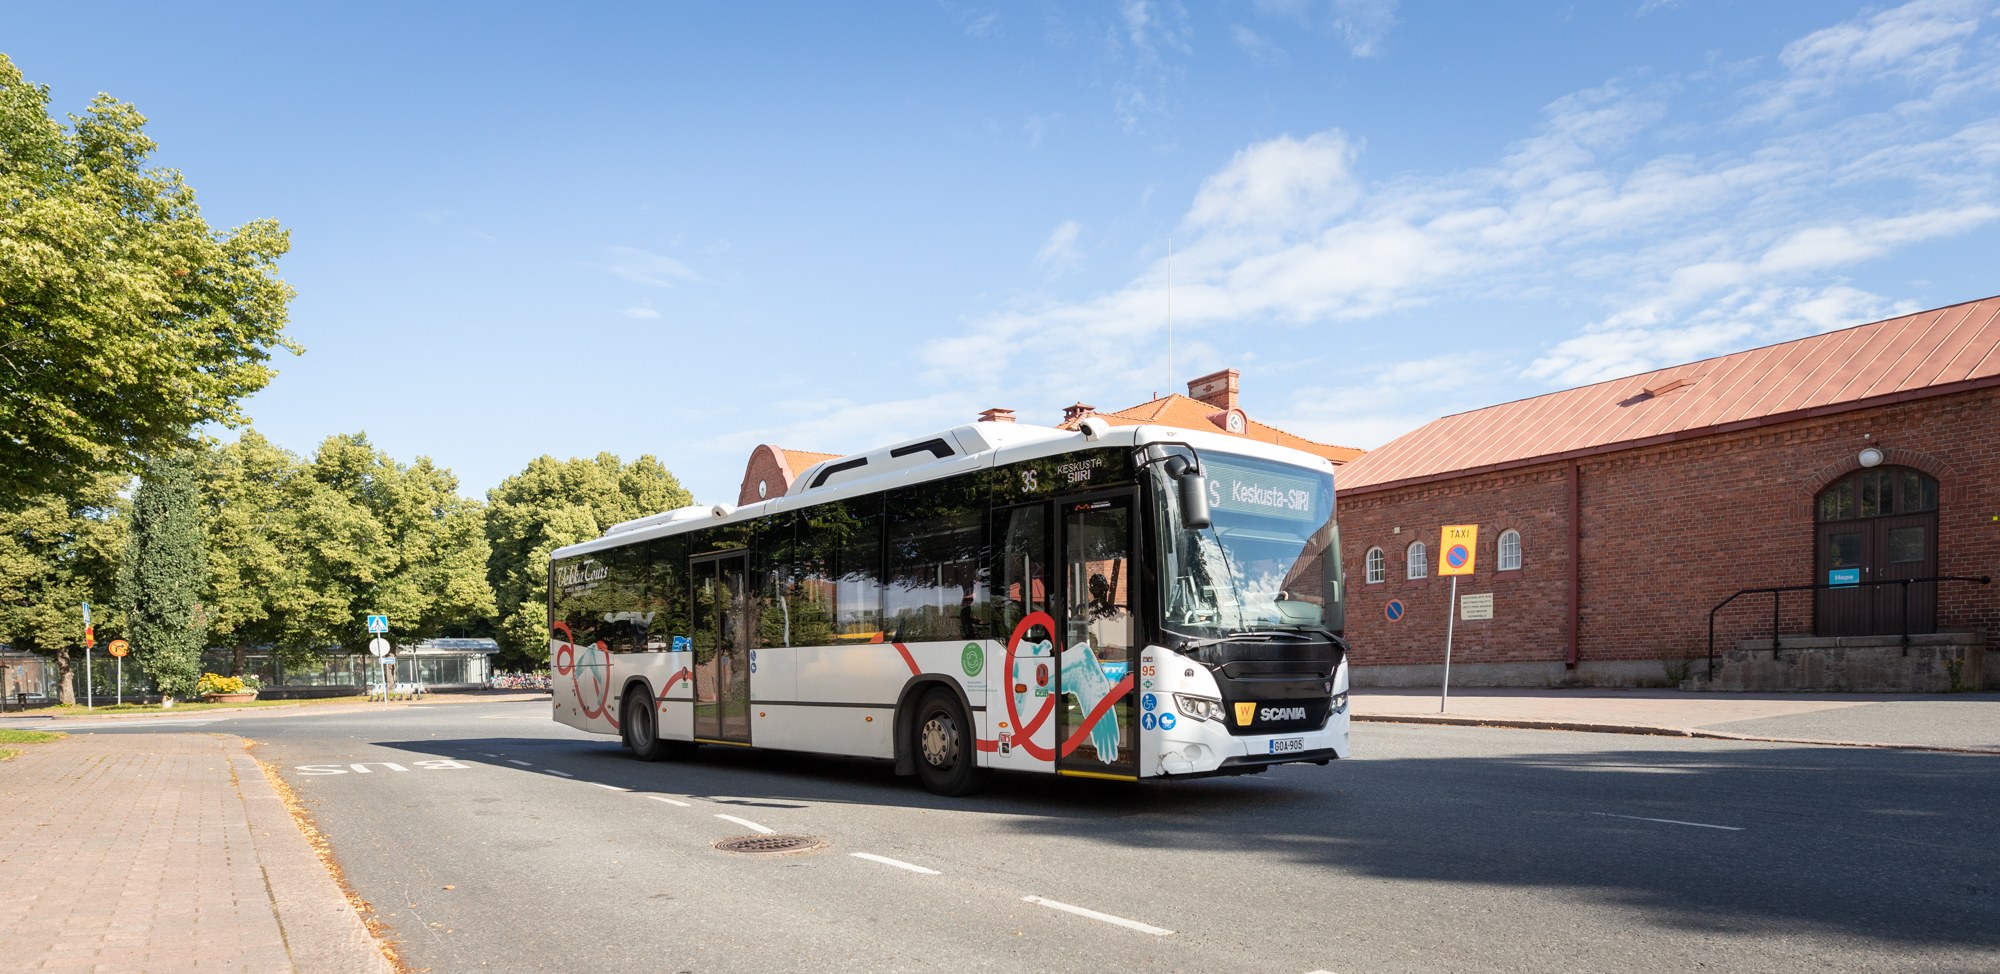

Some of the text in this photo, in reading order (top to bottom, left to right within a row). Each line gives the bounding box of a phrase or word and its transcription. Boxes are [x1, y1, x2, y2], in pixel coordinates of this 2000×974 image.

[1057, 458, 1102, 474] KESKUSTA
[1067, 469, 1091, 483] SIIRI
[1232, 480, 1309, 511] Keskusta-SIIRI
[1450, 529, 1469, 539] TAXI
[583, 559, 609, 581] Tours
[1142, 665, 1155, 677] 95
[1260, 707, 1306, 721] SCANIA
[1274, 739, 1303, 752] GOA-905
[294, 759, 473, 776] BUS
